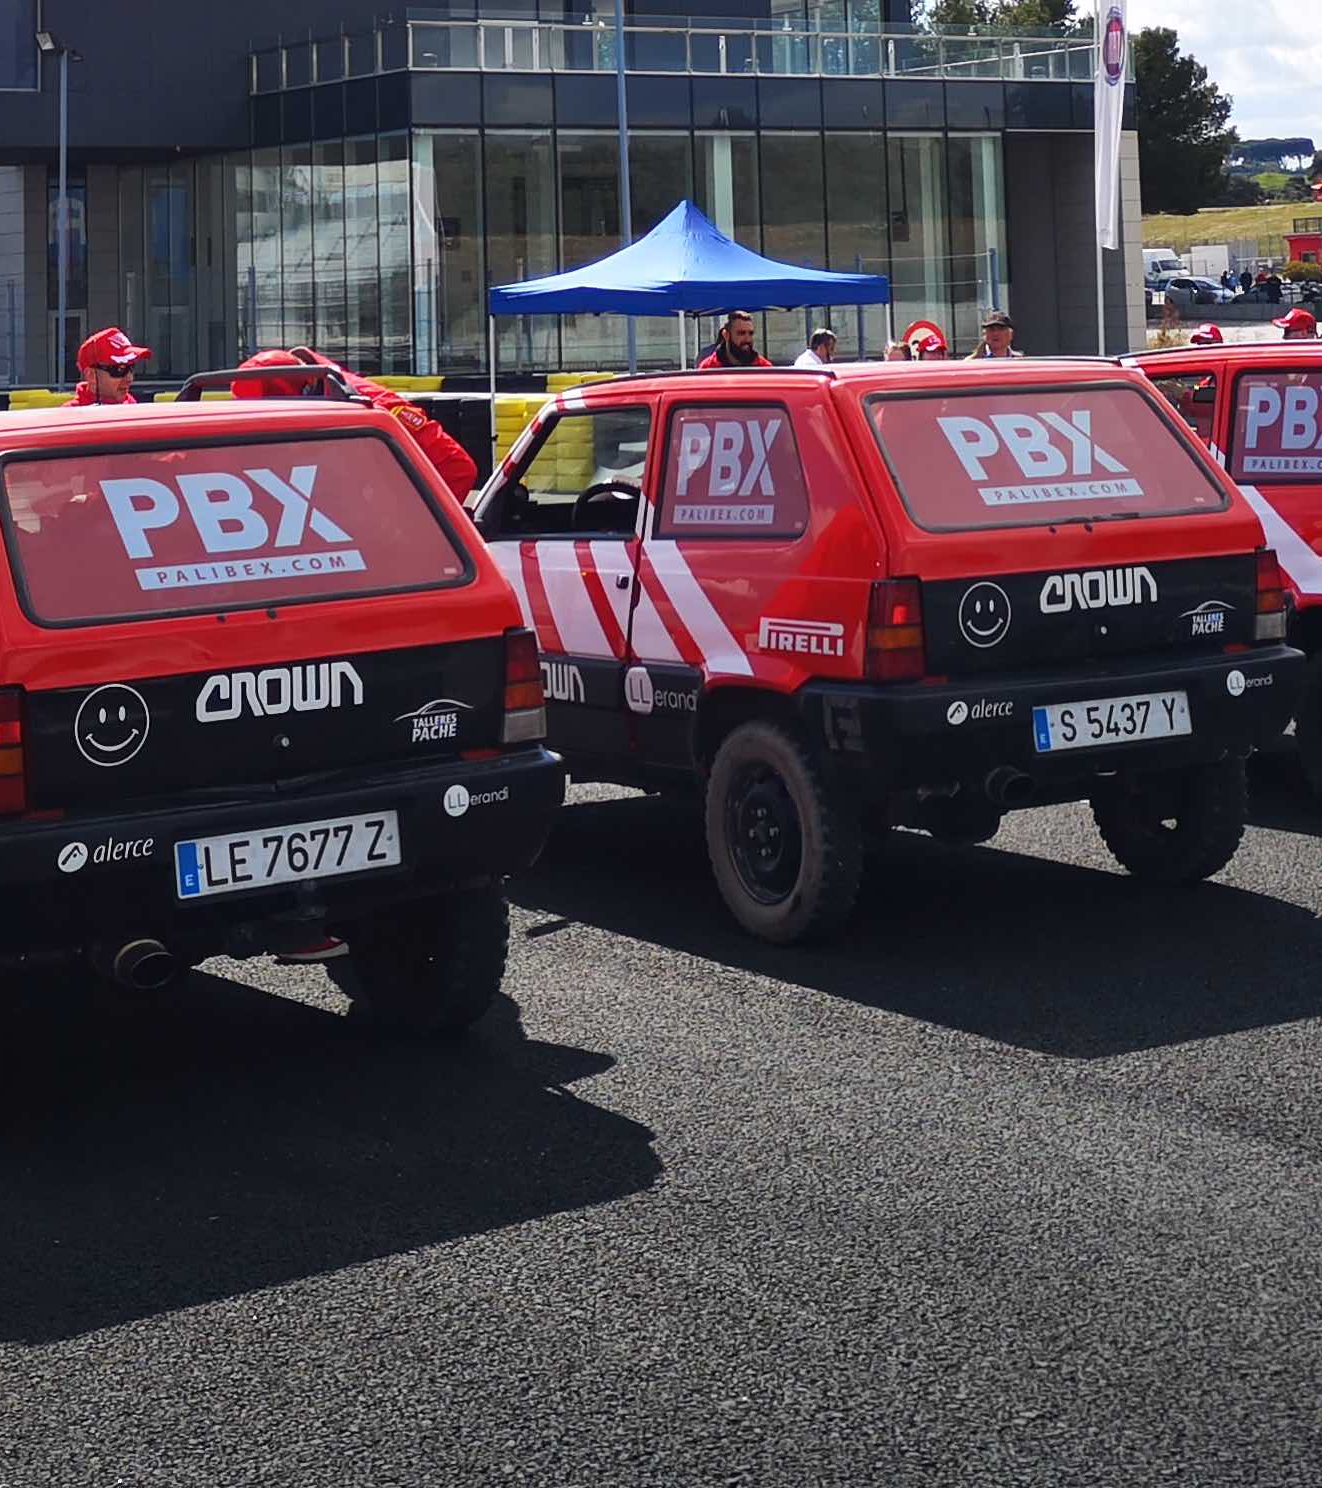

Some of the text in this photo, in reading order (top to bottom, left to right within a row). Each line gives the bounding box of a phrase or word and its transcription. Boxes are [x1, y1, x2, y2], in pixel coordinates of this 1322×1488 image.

[676, 419, 781, 496] PBX
[936, 410, 1129, 480] PBX
[994, 482, 1126, 500] PALIBEX.COM
[99, 464, 354, 560] PBX
[157, 556, 346, 584] PALIBEX.COM
[1040, 566, 1158, 614] CROWN
[757, 616, 844, 656] PIRELLI
[1191, 622, 1224, 636] PACHE
[196, 661, 364, 723] CROWN
[413, 713, 458, 728] TALLERES
[971, 699, 1014, 720] alerce
[1061, 698, 1178, 742] S 5437 Y
[412, 723, 457, 743] PACHE
[93, 836, 155, 864] alerce
[204, 819, 388, 887] LE 7677 Z
[185, 874, 195, 887] E
